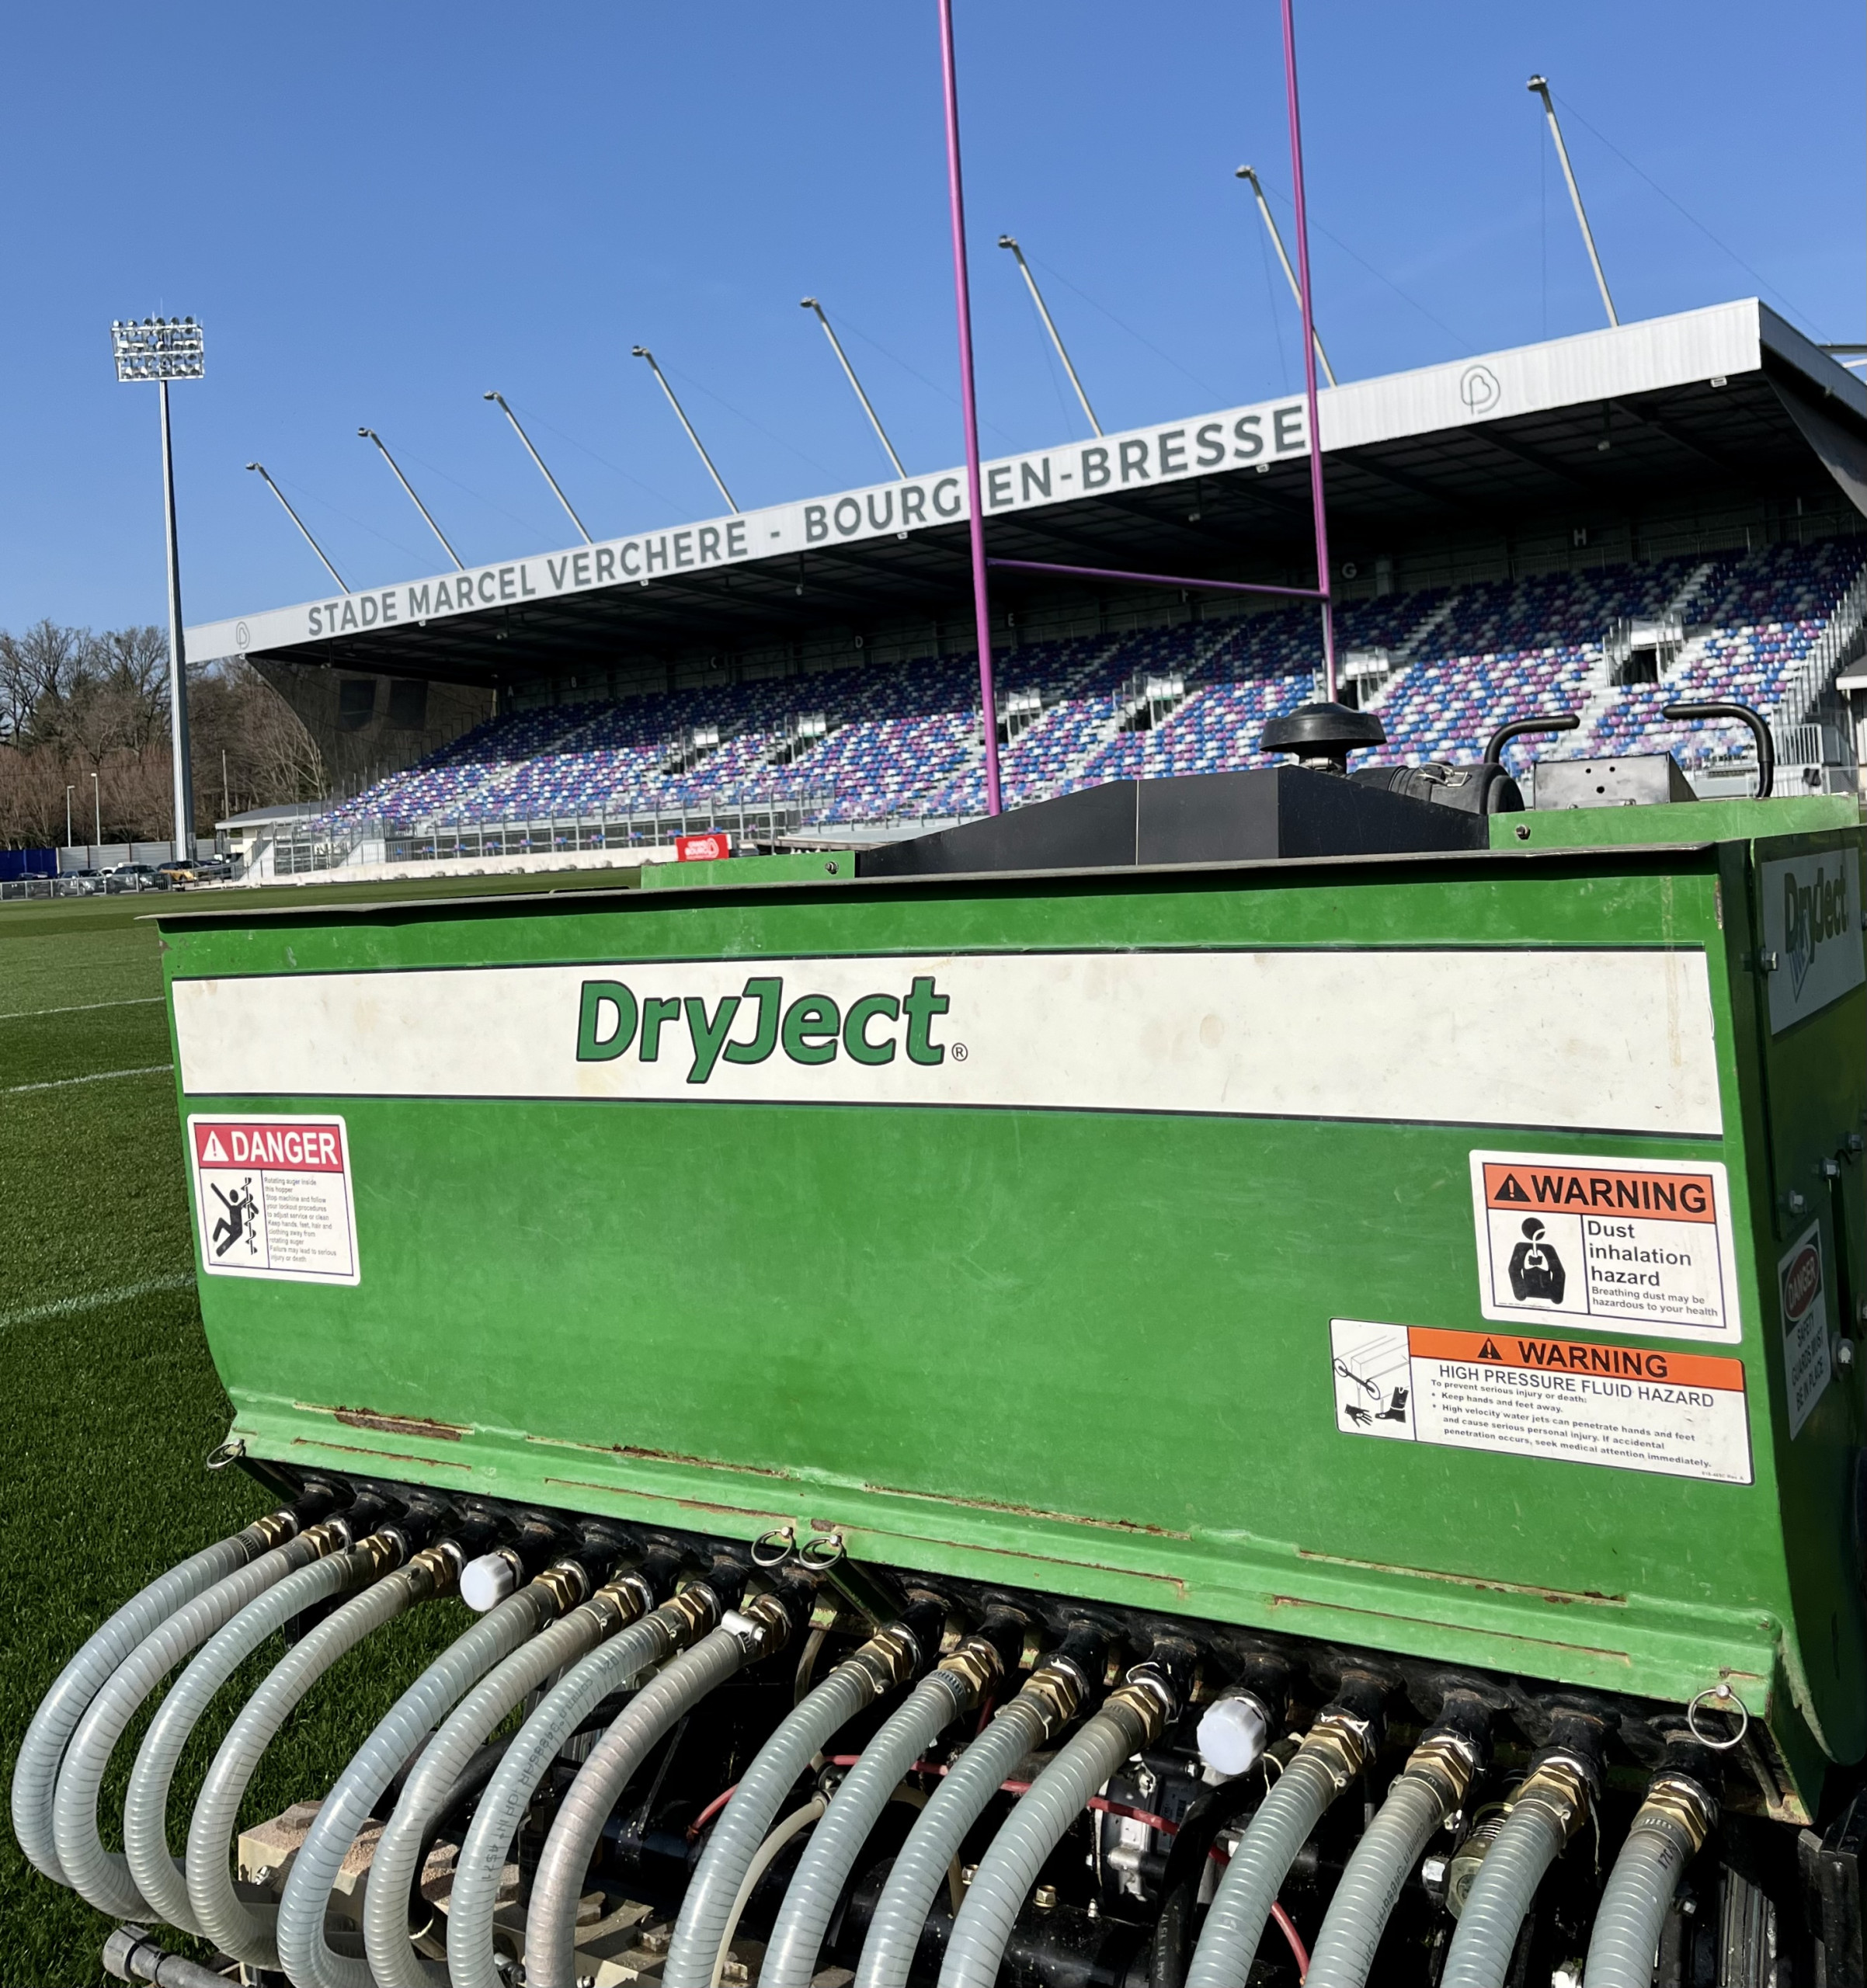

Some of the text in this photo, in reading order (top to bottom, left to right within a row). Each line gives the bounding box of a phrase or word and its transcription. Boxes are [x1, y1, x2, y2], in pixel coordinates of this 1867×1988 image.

[1574, 528, 1586, 546] H
[308, 590, 398, 636] STADE
[409, 564, 536, 618] MARCEL
[546, 520, 749, 591] VERCHERE
[1341, 561, 1358, 579] G
[855, 635, 863, 648] D
[231, 1131, 339, 1165] DANGER
[264, 1176, 285, 1186] Rotating
[266, 1194, 277, 1202] Stop
[1531, 1174, 1706, 1214] WARNING
[1587, 1220, 1636, 1239] Dust
[269, 1237, 289, 1246] rotating
[1589, 1243, 1692, 1267] inhalation
[1591, 1267, 1660, 1287] hazard
[1789, 1255, 1817, 1311] DANGER
[1592, 1287, 1705, 1305] Breathing dust may be
[1592, 1298, 1719, 1317] hazardous to your health
[1518, 1340, 1668, 1378] WARNING
[1439, 1364, 1714, 1407] HIGH PRESSURE FLUID HAZARD
[1445, 1382, 1478, 1391] prevent
[1480, 1386, 1514, 1395] serious
[1516, 1388, 1542, 1399] injury
[1557, 1393, 1587, 1403] death:
[1441, 1392, 1464, 1402] Keep
[1466, 1395, 1493, 1404] hands
[1515, 1400, 1534, 1409] feet
[1537, 1404, 1563, 1413] away.
[1442, 1404, 1462, 1413] High
[1465, 1408, 1500, 1419] velocity
[1531, 1415, 1550, 1423] jets
[1572, 1421, 1618, 1432] penetrate
[1622, 1426, 1651, 1436] hands
[1675, 1432, 1695, 1441] feet
[1491, 1423, 1525, 1432] serious
[1527, 1427, 1568, 1437] personal
[1570, 1431, 1599, 1443] injury.
[1613, 1438, 1664, 1449] accidental
[1444, 1429, 1496, 1440] penetration
[1498, 1435, 1532, 1445] occurs,
[1560, 1443, 1598, 1452] medical
[1601, 1448, 1645, 1458] attention
[1647, 1453, 1712, 1468] immediately.
